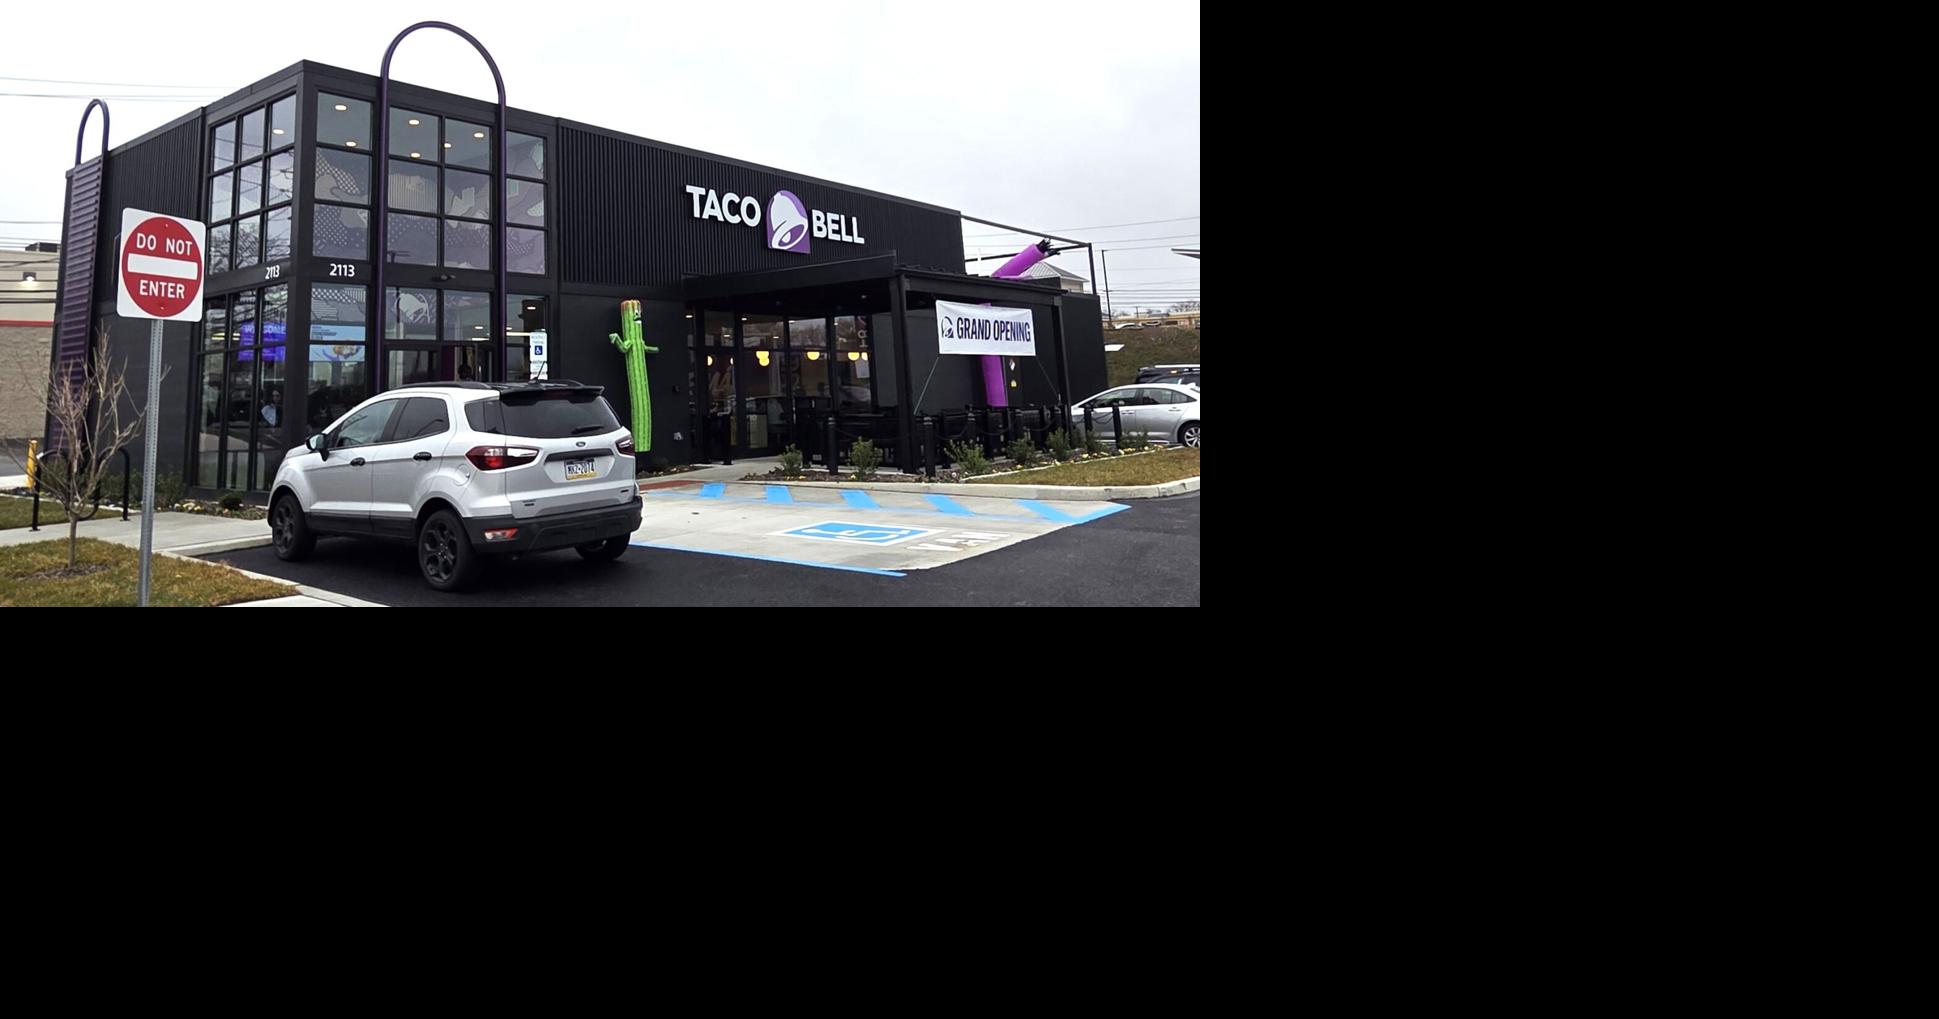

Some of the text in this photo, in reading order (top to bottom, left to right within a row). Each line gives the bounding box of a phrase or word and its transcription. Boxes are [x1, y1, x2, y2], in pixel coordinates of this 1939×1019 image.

[685, 184, 865, 245] TACO BELL
[136, 232, 193, 256] DO NOT
[264, 265, 281, 280] 2113
[329, 263, 356, 278] 2113
[139, 279, 186, 300] ENTER
[956, 316, 1031, 342] GRAND OPENING
